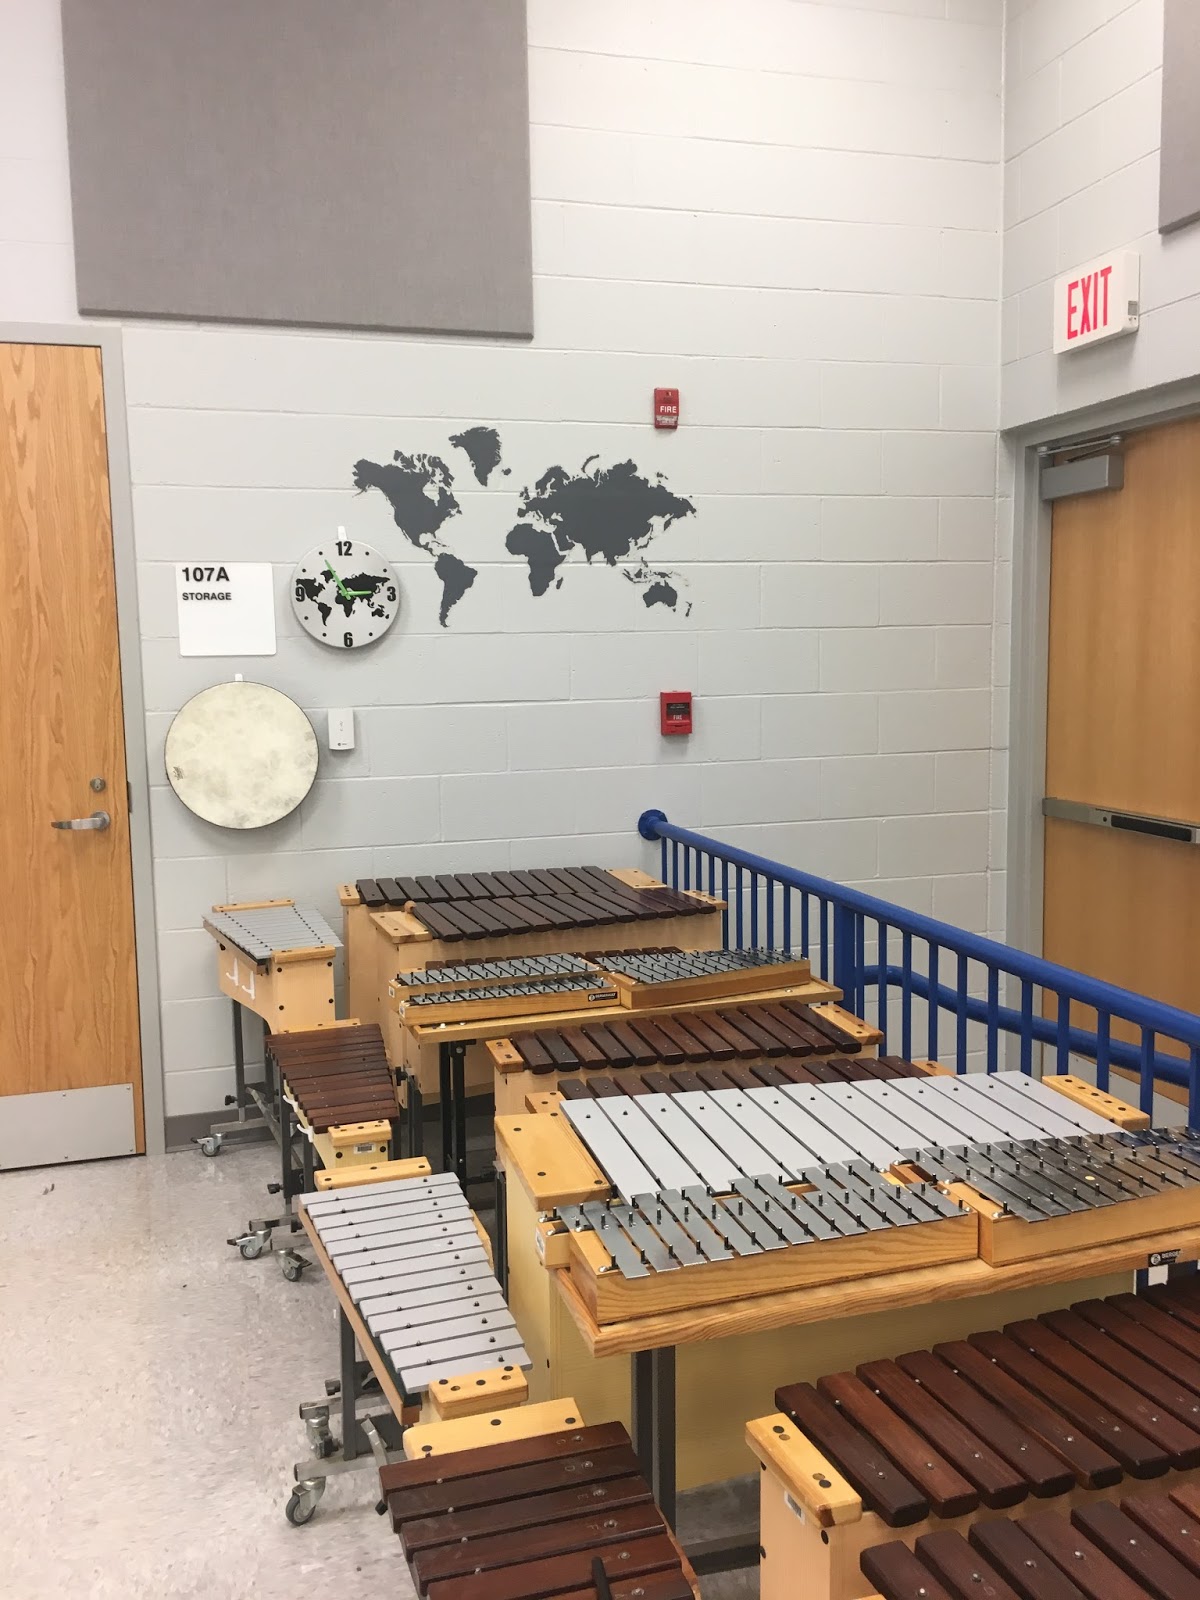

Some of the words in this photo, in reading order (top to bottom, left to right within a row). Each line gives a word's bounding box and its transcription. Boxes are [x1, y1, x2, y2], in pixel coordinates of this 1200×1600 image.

[1067, 265, 1112, 340] EXIT
[660, 405, 677, 414] FIRE
[335, 540, 353, 557] 12
[182, 566, 230, 582] 107A
[182, 592, 232, 601] STORAGE
[295, 586, 306, 602] 9
[386, 586, 397, 602] 3
[343, 631, 354, 648] 6
